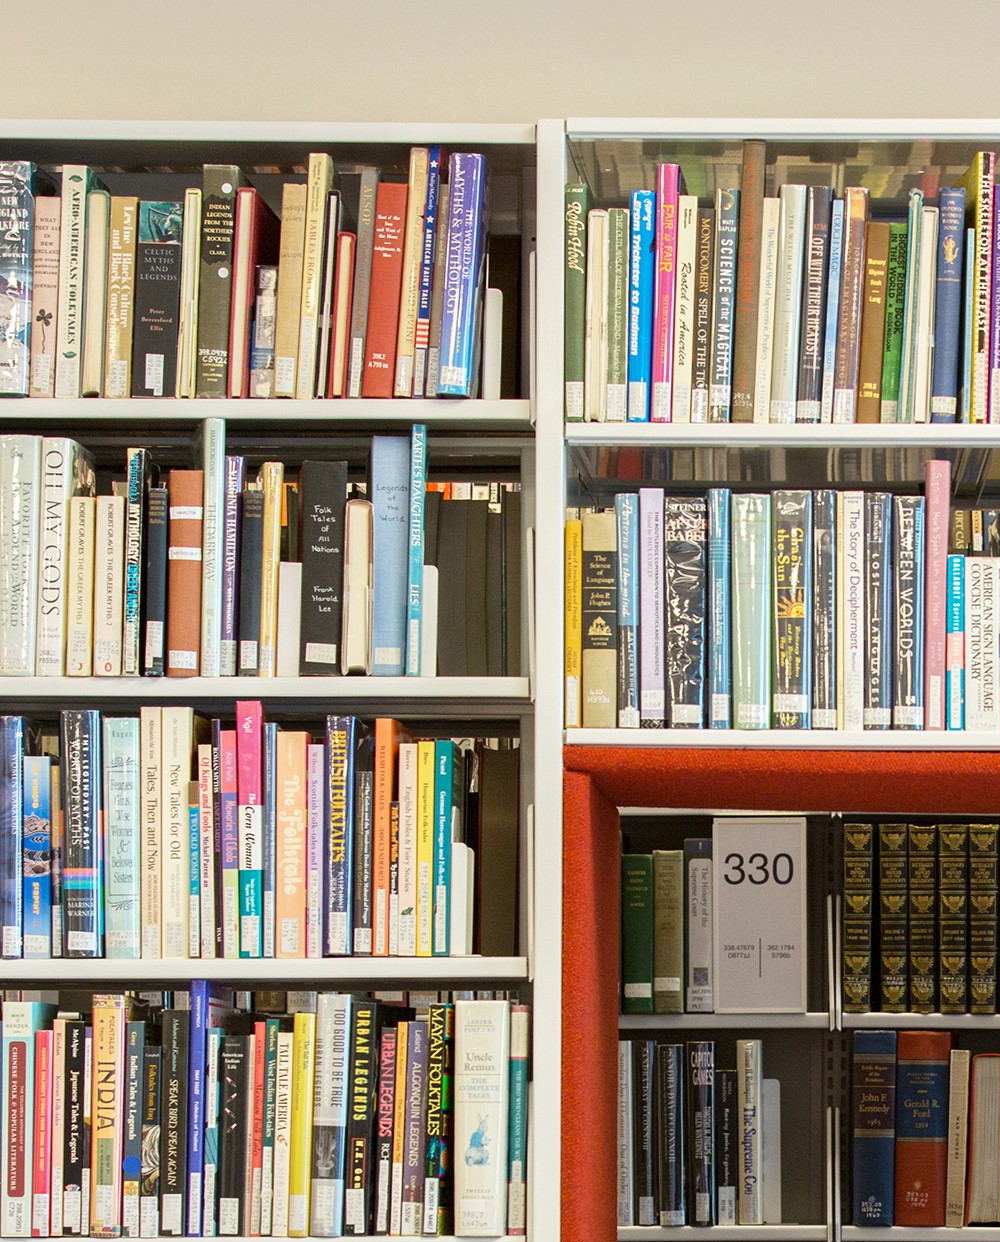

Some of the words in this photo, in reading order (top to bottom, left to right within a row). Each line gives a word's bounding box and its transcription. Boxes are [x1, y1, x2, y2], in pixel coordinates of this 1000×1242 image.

[70, 188, 80, 280] AFRO-AMERICAN
[144, 248, 174, 256] CELTIC
[140, 273, 178, 282] LEGENDS
[144, 257, 175, 265] MYTHS
[149, 265, 169, 273] AND
[720, 239, 733, 293] SCIENCE
[67, 284, 77, 345] FOLKTALES
[44, 449, 64, 490] OH
[44, 500, 62, 537] MY
[668, 503, 707, 511] STEINER
[899, 507, 914, 580] BETWEEN
[41, 544, 61, 616] GODS
[899, 590, 914, 658] WORLDS
[243, 716, 253, 734] Vigil
[146, 765, 158, 794] Tales,
[146, 797, 158, 821] Then
[146, 822, 158, 839] and
[146, 843, 158, 871] Now
[724, 853, 794, 885] 330
[356, 1009, 371, 1054] URBAN
[431, 1007, 444, 1055] MAYAN
[381, 1033, 395, 1073] URBAN
[463, 1062, 495, 1071] Remus
[466, 1053, 493, 1062] Uncle
[97, 1061, 116, 1131] INDIA
[353, 1059, 369, 1121] LEGENDS
[379, 1078, 394, 1138] LEGENDS
[410, 1061, 421, 1119] ALGONQUIN
[427, 1058, 442, 1136] FOLKTALES
[904, 1099, 929, 1108] Gerald
[859, 1104, 890, 1115] Kennedy
[913, 1109, 931, 1118] Ford
[409, 1121, 419, 1167] LEGENDS
